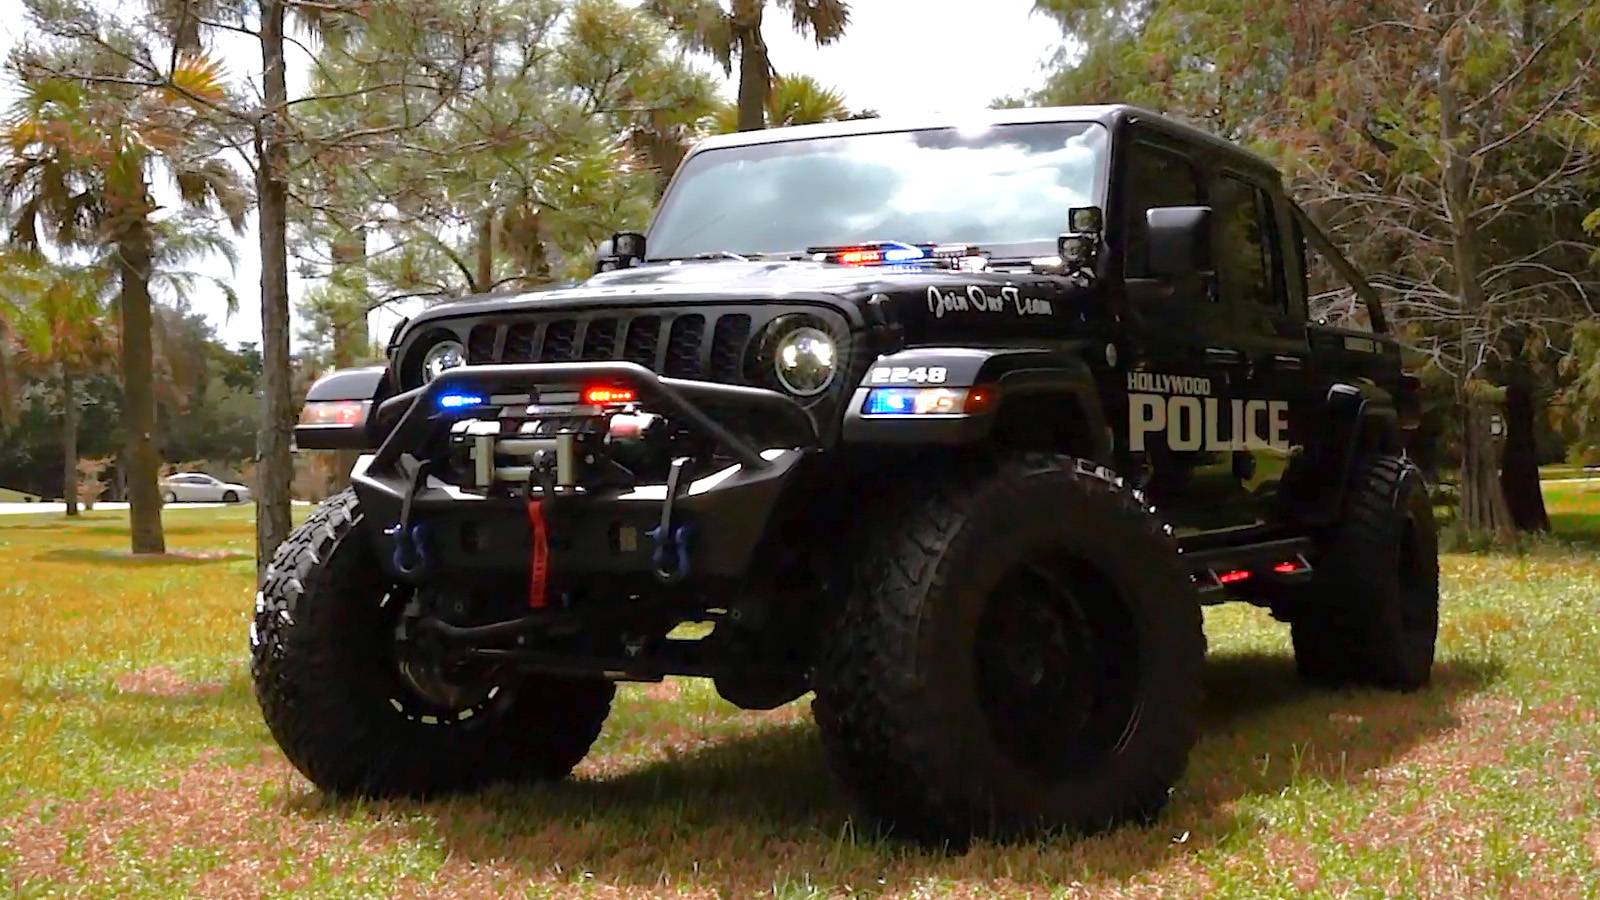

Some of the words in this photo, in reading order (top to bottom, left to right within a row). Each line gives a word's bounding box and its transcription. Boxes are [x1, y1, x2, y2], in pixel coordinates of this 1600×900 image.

[927, 285, 969, 318] Join
[966, 285, 1003, 312] Our
[1001, 286, 1053, 315] Team
[871, 366, 947, 384] 2248
[1127, 371, 1211, 396] HOLLYWOOD
[1128, 392, 1290, 452] POLICE
